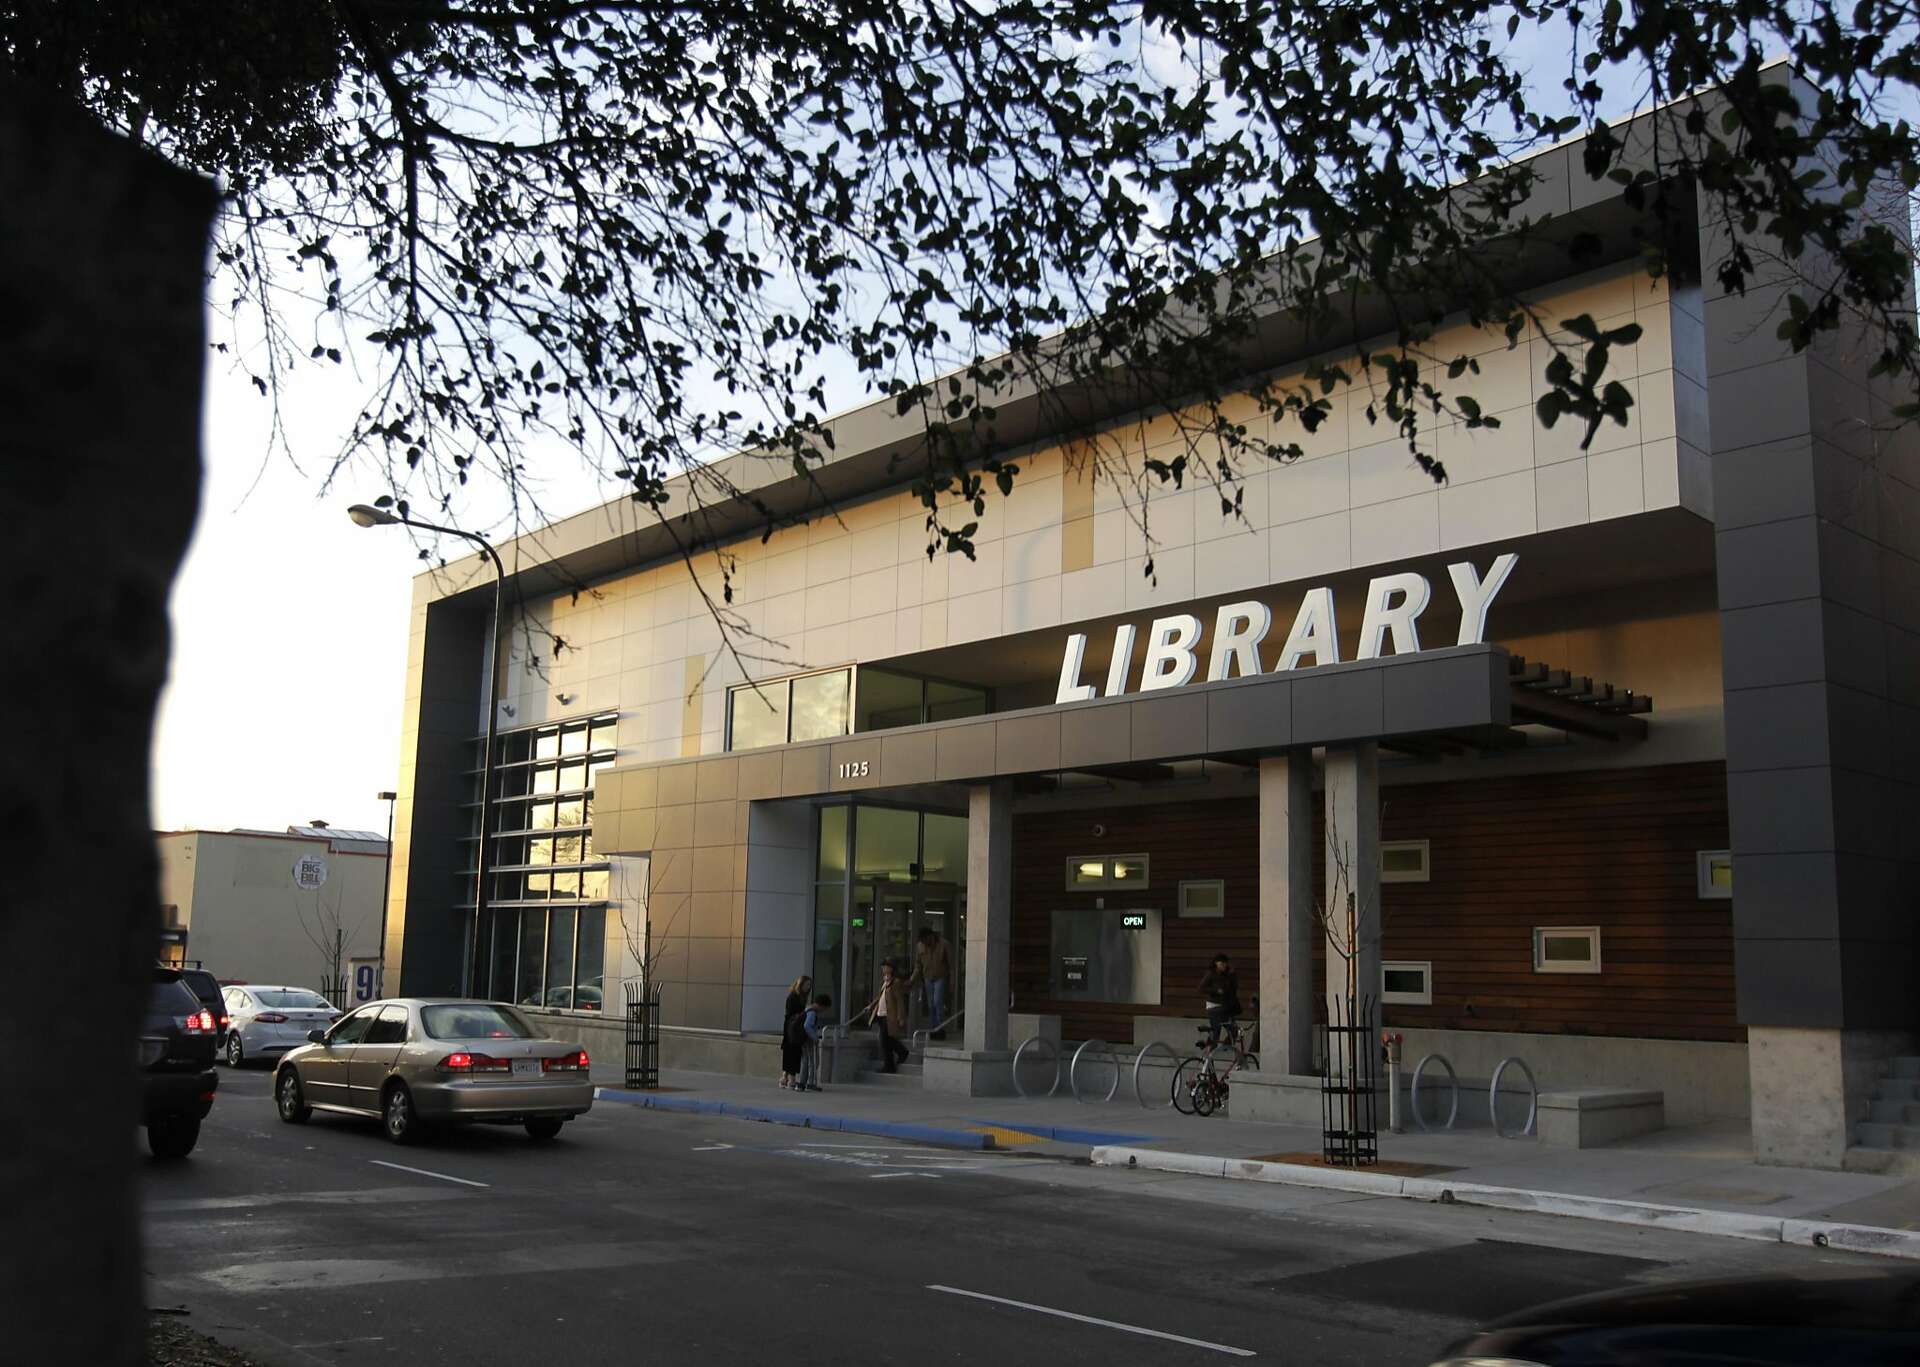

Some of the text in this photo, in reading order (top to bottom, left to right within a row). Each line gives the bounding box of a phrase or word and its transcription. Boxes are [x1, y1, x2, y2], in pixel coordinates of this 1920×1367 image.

[1055, 553, 1519, 704] LIBRARY
[839, 761, 869, 779] 1125
[301, 863, 320, 873] BIG
[1123, 916, 1143, 926] OPEN
